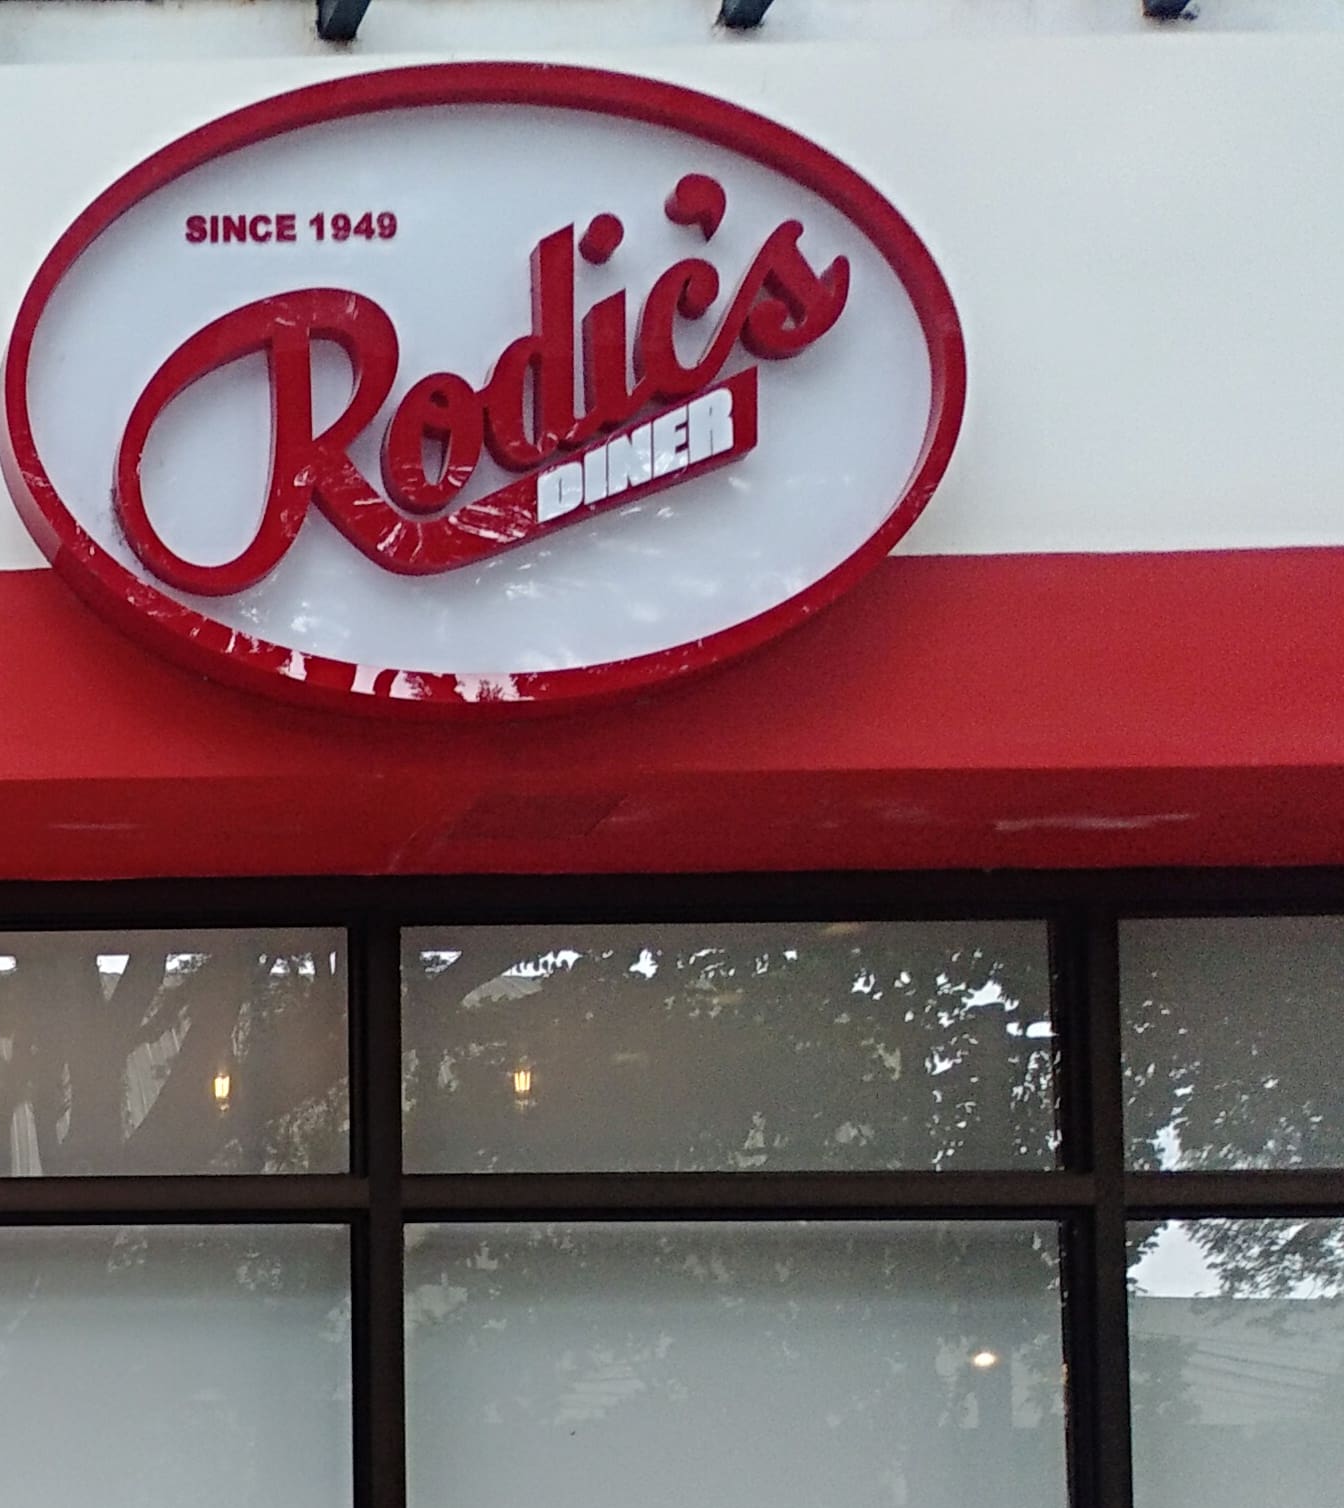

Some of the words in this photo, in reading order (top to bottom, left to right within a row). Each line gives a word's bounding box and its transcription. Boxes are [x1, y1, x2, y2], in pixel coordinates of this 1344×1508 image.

[184, 213, 297, 244] SINCE
[309, 210, 399, 244] 1949
[115, 173, 852, 596] Rodic's
[535, 387, 736, 525] DINER
